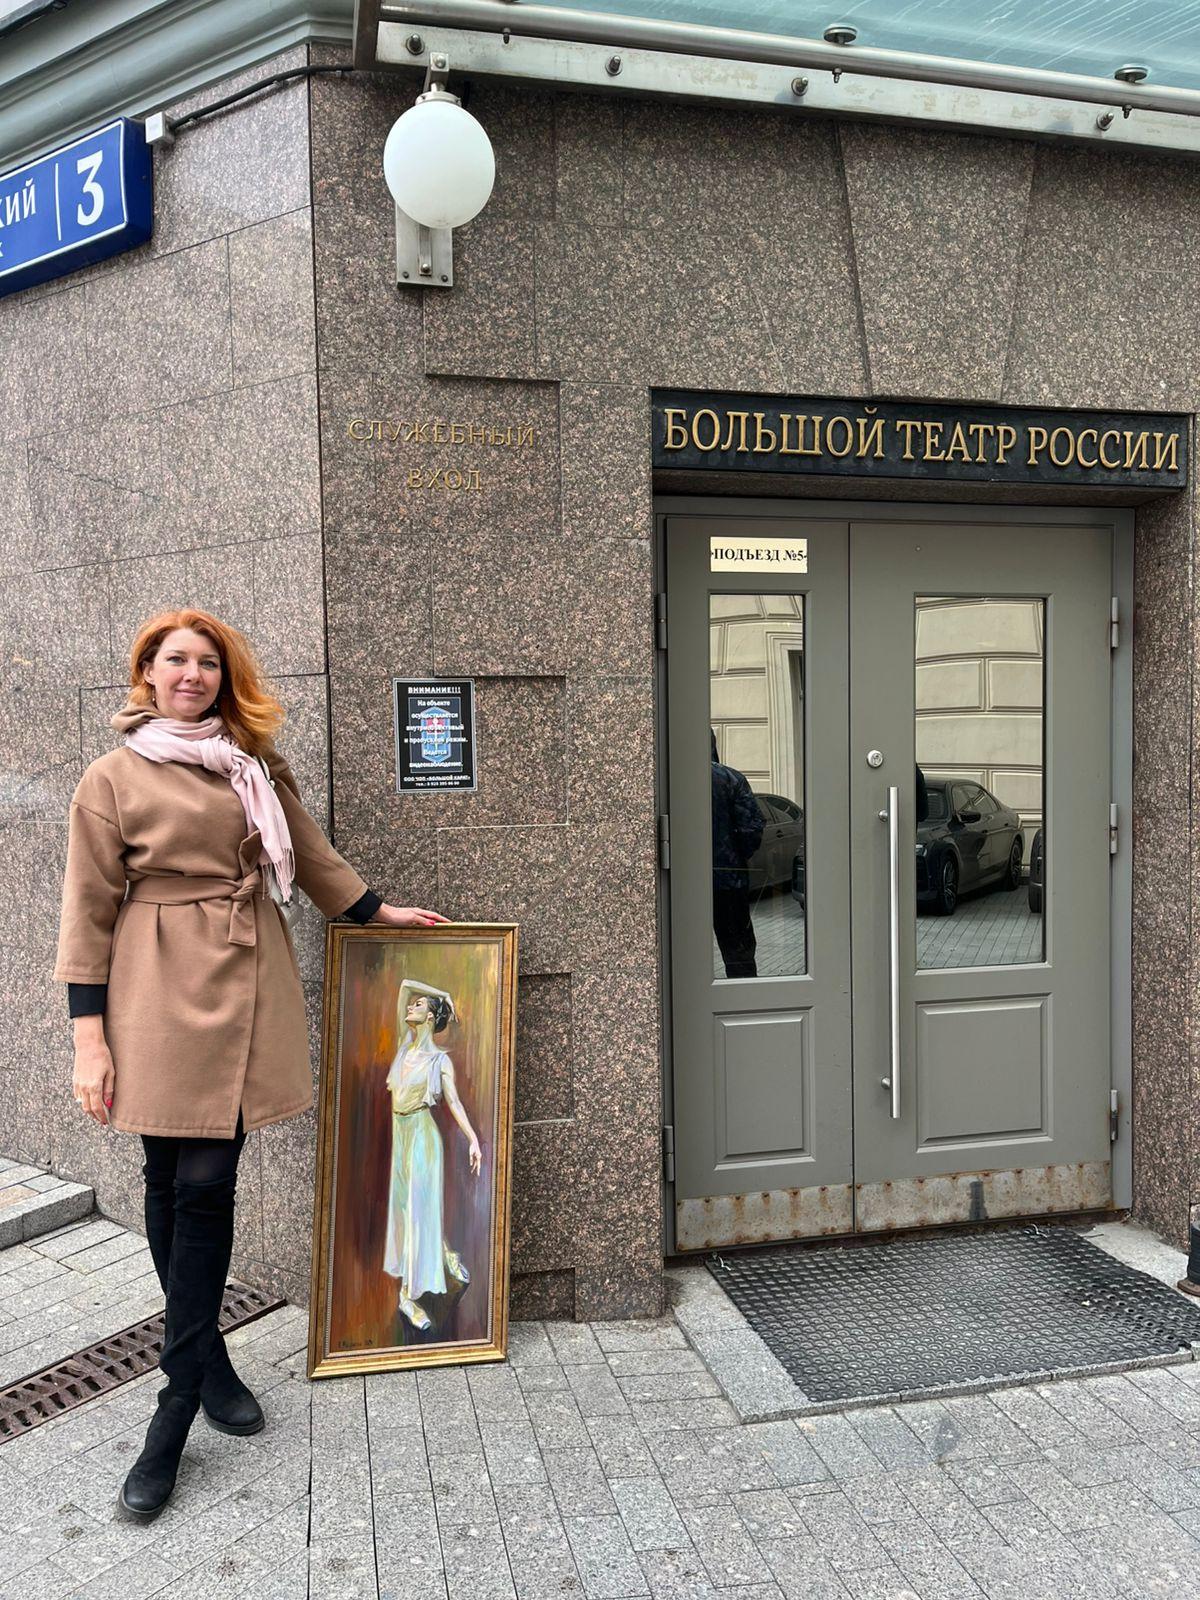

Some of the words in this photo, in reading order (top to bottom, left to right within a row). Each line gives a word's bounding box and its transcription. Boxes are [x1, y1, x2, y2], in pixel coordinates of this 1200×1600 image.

[77, 150, 104, 226] 3
[349, 418, 535, 448] СЛУЖЕБНЫЙ
[664, 406, 886, 458] БОЛЬШОЙ
[896, 419, 1017, 465] ТЕАТР
[1027, 426, 1180, 471] РОССИИ
[408, 467, 482, 491] ВХОД
[714, 548, 780, 562] ПОДЪЕЗД
[408, 686, 461, 694] ВНИМАНИЕ!!!
